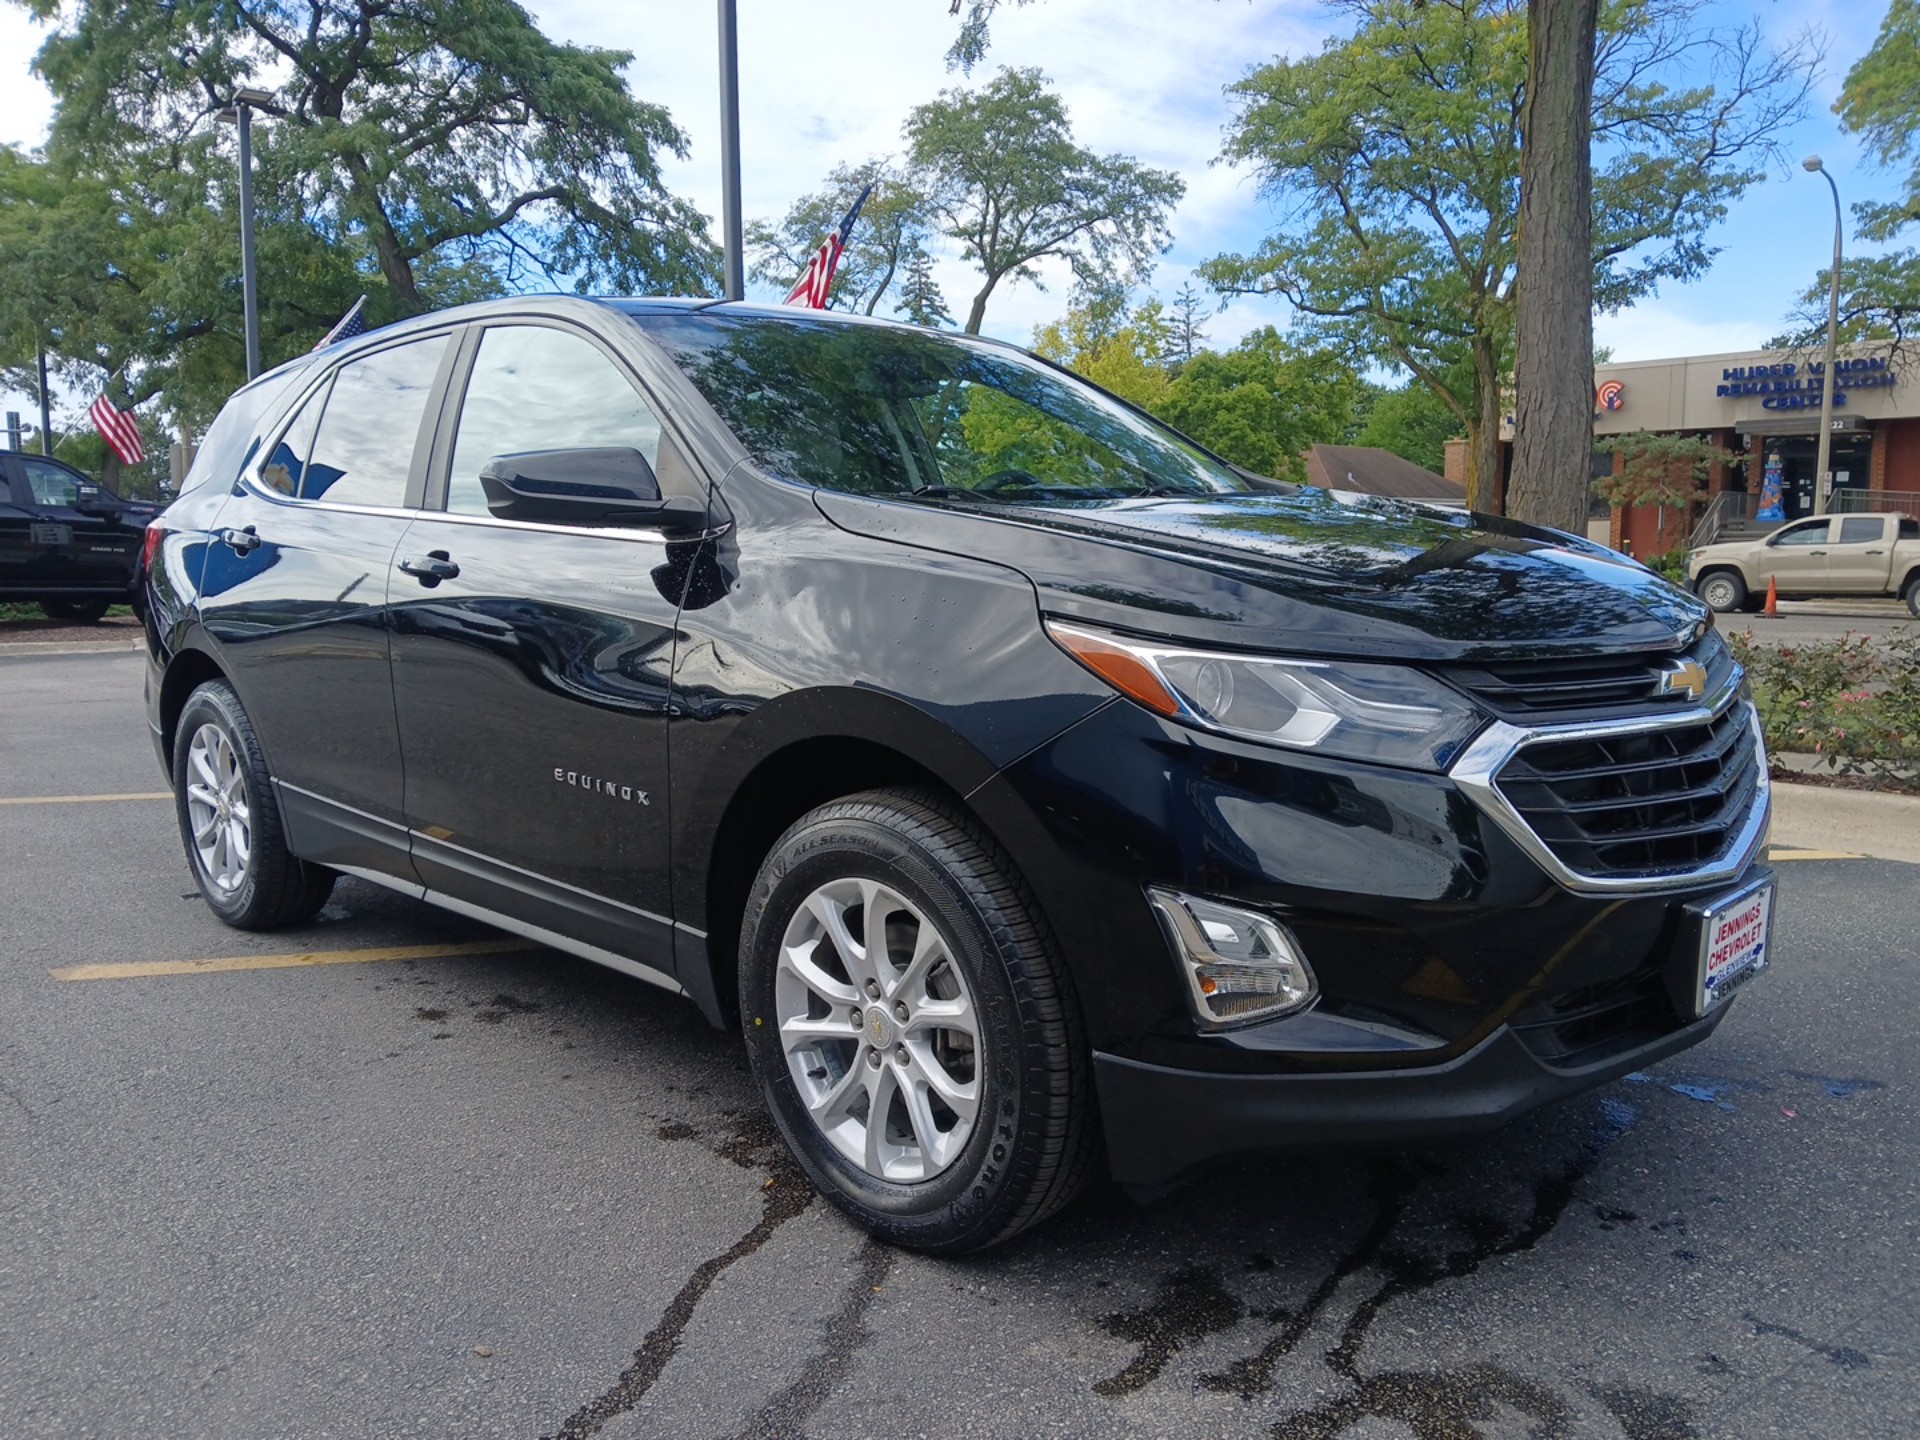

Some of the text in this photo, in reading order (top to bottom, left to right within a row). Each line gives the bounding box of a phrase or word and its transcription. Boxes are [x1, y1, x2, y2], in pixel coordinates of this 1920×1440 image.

[1722, 363, 1797, 381] HUBER
[1762, 392, 1847, 410] CENTR
[553, 767, 651, 806] EQUINOX
[1715, 902, 1762, 945] JENNINGS
[1708, 922, 1763, 971] CHEVROLET
[1715, 949, 1755, 981] GLENVIEW
